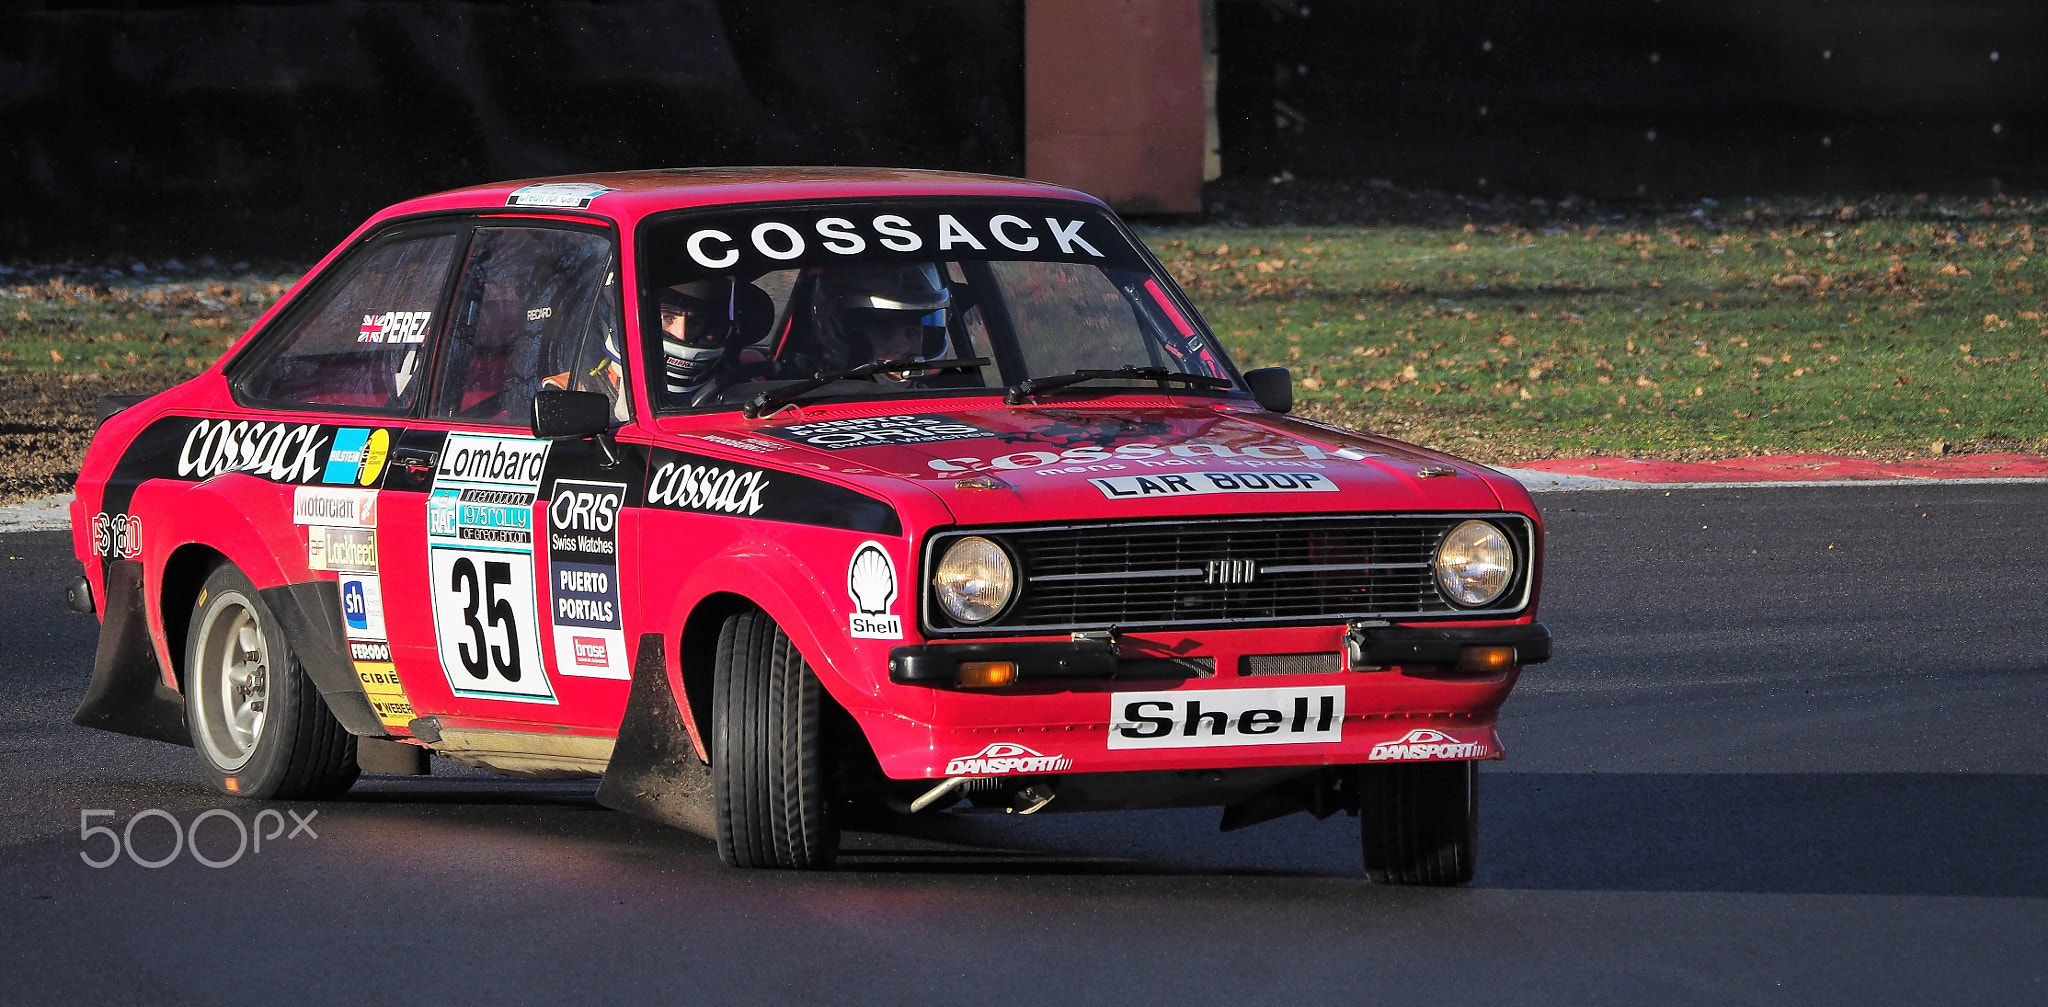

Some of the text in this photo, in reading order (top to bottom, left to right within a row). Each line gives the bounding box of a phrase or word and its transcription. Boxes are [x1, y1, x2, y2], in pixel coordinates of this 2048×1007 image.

[686, 214, 1105, 268] COSSACK
[380, 311, 432, 343] PEREZ
[807, 424, 978, 443] ORIS
[329, 450, 361, 463] BILSTEIN
[439, 439, 549, 481] Lombard
[1035, 458, 1327, 476] mens hair spray
[1100, 471, 1323, 497] LAR 800P
[296, 494, 354, 519] Motorcraft
[551, 490, 618, 532] ORIS
[430, 509, 456, 535] RAC
[327, 533, 376, 567] Lockheed
[552, 533, 613, 554] Swiss Watches
[560, 570, 608, 593] PUERTO
[1205, 559, 1255, 584] FORD
[345, 586, 364, 614] sh
[559, 598, 614, 623] PORTALS
[451, 557, 522, 683] 35
[853, 618, 898, 634] Shell
[350, 643, 389, 660] FERODO
[574, 639, 606, 658] brose
[1120, 695, 1334, 738] Shell
[1368, 742, 1475, 760] DANSPORT
[945, 756, 1060, 775] DANSPORT
